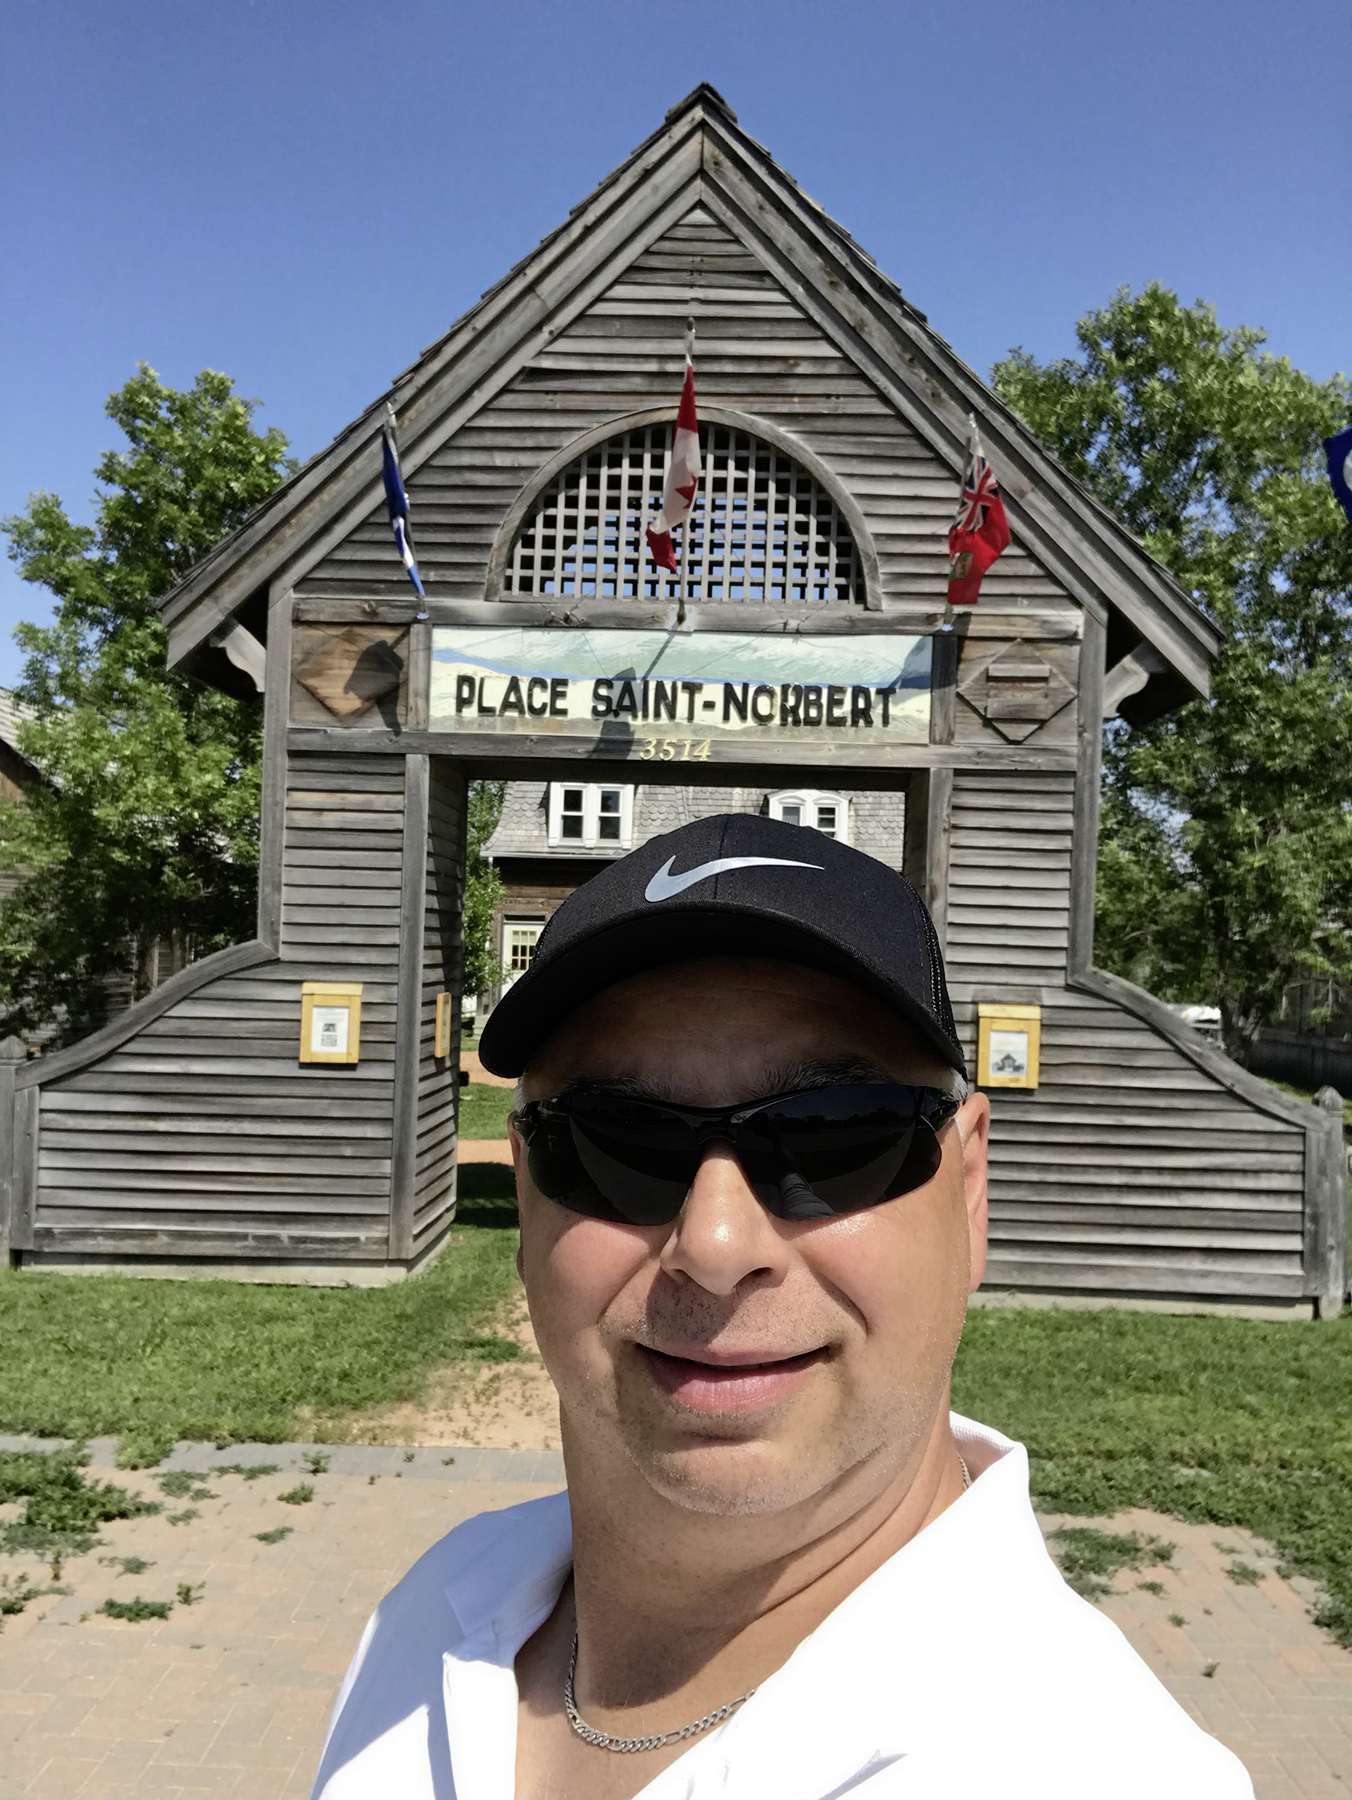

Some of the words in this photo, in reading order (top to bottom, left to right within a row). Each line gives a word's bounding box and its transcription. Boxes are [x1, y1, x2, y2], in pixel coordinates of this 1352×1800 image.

[455, 674, 569, 718] PLACE
[591, 676, 897, 728] SAINT-NORBERT
[639, 737, 712, 762] 3514
